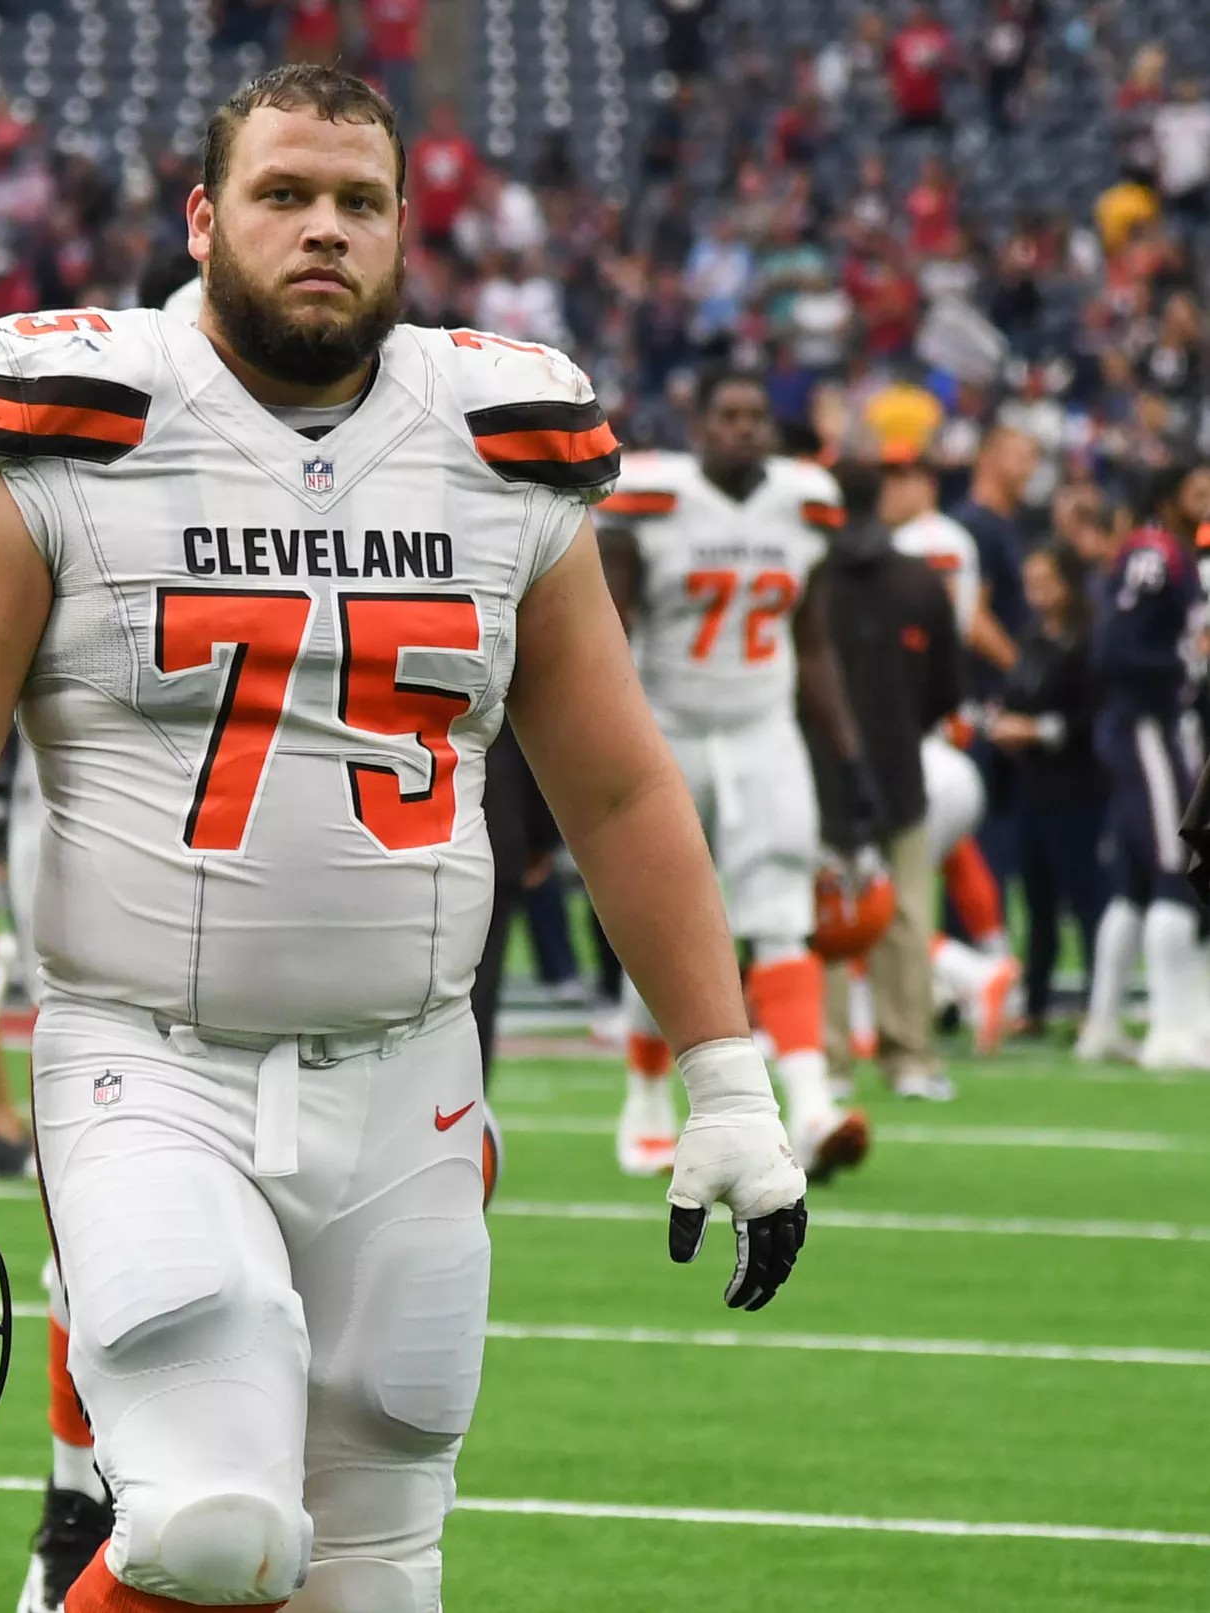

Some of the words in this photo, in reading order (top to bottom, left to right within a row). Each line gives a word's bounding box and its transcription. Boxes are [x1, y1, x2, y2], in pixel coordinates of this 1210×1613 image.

[306, 473, 332, 490] NFL
[183, 526, 454, 579] CLEVELAND
[684, 567, 800, 663] 72
[153, 585, 482, 852] 75
